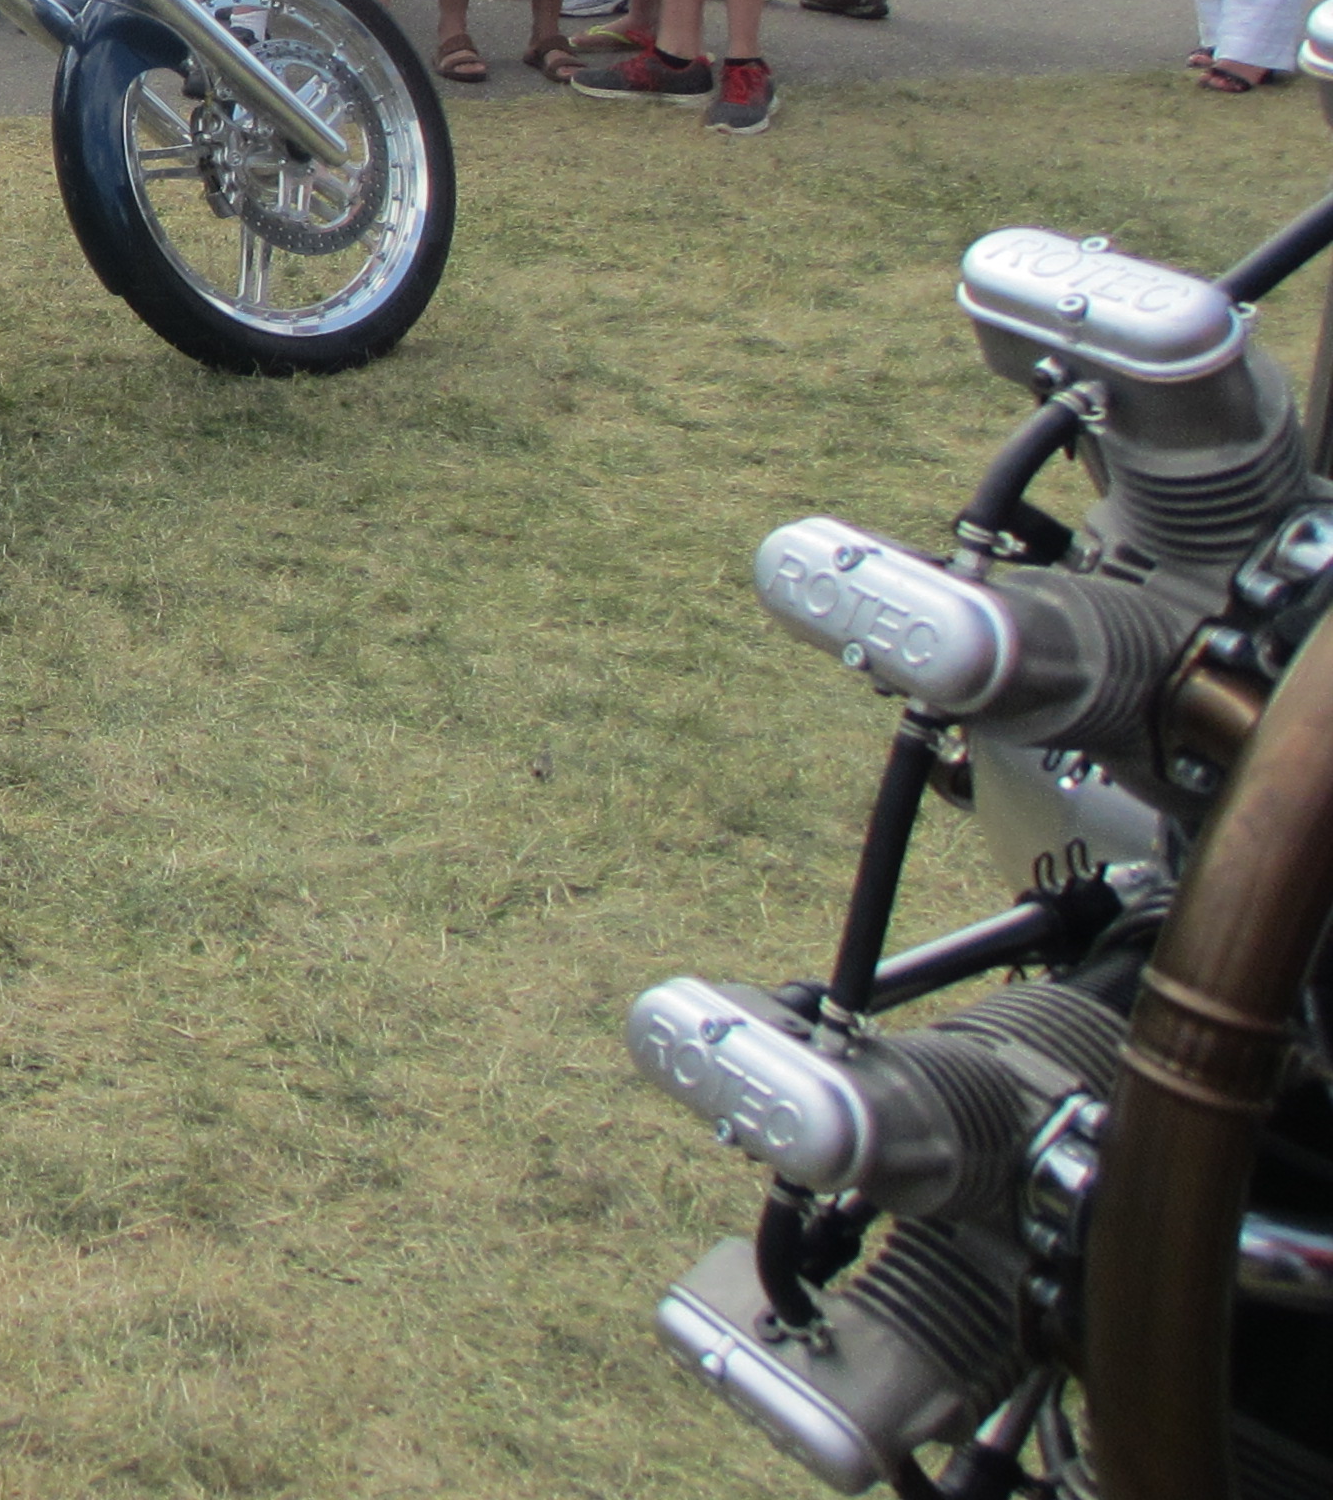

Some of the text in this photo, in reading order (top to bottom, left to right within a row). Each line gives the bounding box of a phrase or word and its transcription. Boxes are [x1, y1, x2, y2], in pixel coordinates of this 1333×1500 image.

[985, 237, 1190, 313] ROTEC
[766, 548, 938, 667] ROTEC
[639, 1013, 803, 1148] ROTEC
